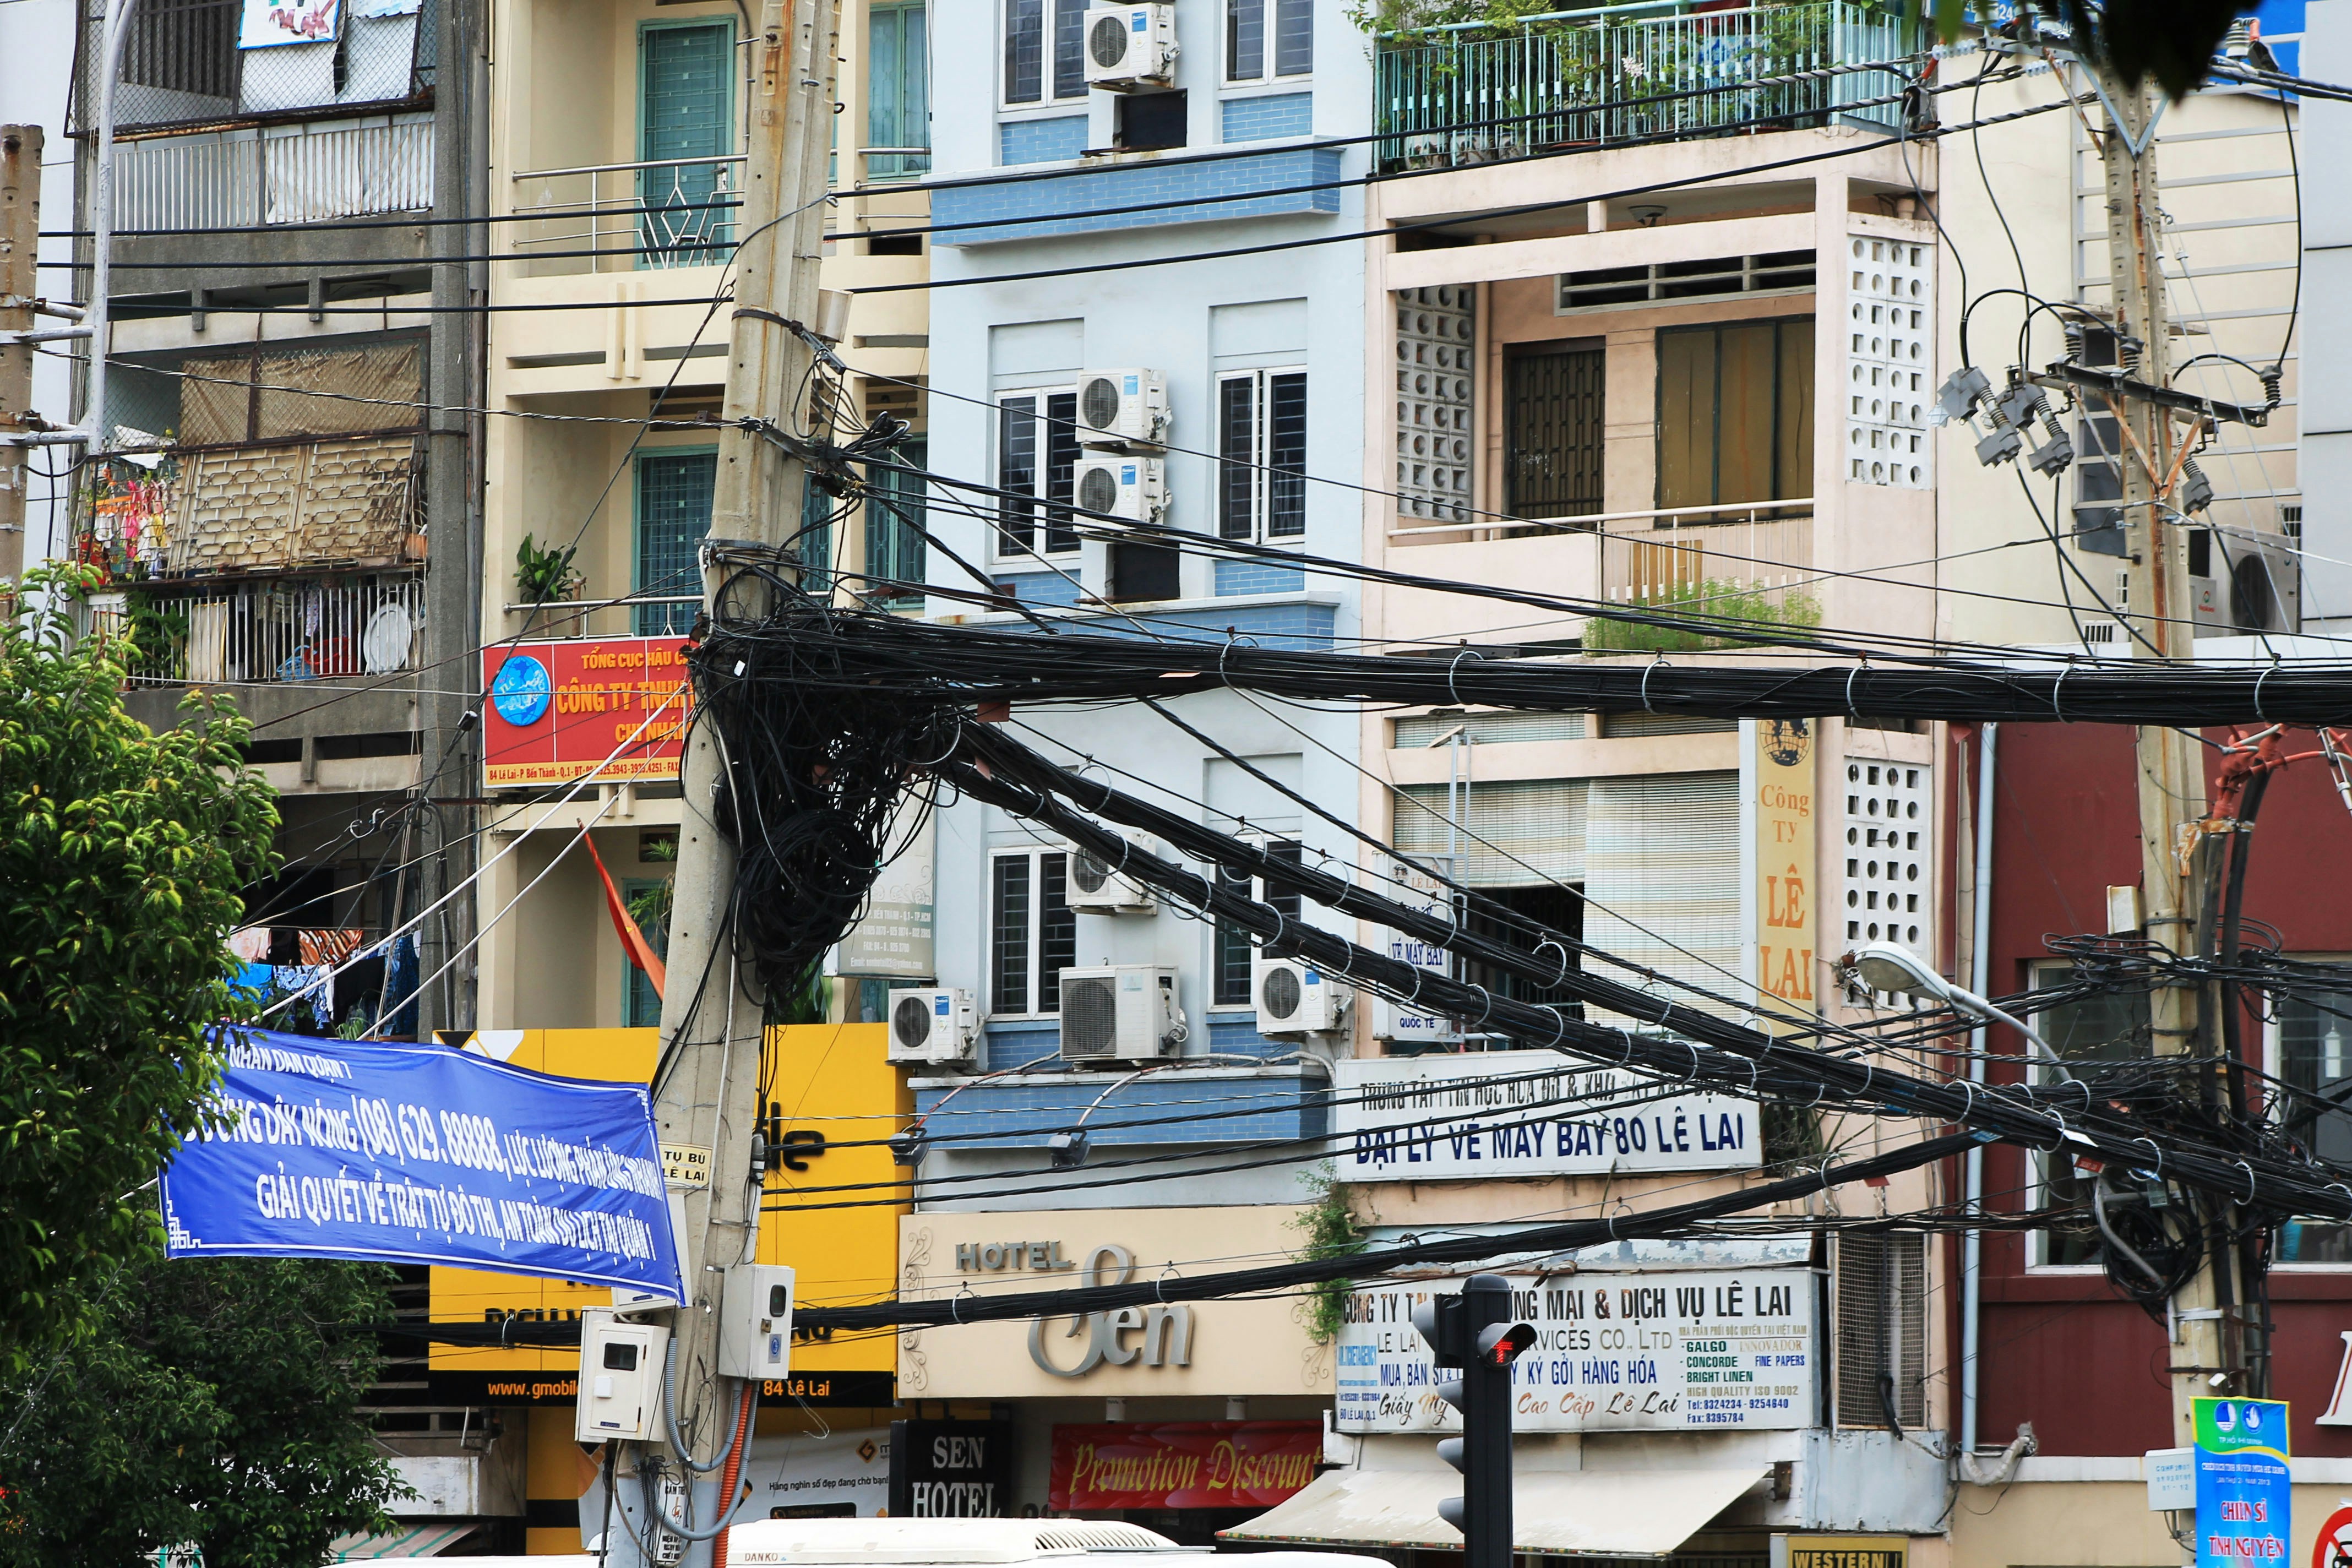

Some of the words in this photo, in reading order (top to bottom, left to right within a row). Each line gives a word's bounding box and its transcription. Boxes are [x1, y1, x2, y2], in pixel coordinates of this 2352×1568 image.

[581, 646, 616, 669] TỔNG
[618, 654, 644, 672] CỤC
[647, 647, 672, 671] HẬU
[557, 677, 605, 714] CÔNG
[609, 683, 633, 711] TY
[615, 723, 643, 742] CHI
[489, 771, 497, 780] 84
[1761, 785, 1809, 817] Công
[1767, 863, 1805, 928] LÊ
[1406, 938, 1423, 965] MÁY
[1427, 948, 1443, 966] BAY
[1761, 945, 1812, 1000] LAI
[1400, 1015, 1421, 1028] QUỐC
[302, 1054, 345, 1084] QUẬN
[259, 1094, 303, 1146] DÂY
[301, 1098, 360, 1153] NÓNG
[350, 1094, 405, 1166] (08)
[1355, 1128, 1397, 1170] ĐẠI
[1407, 1116, 1434, 1163] LÝ
[1449, 1117, 1482, 1161] VÉ
[1492, 1112, 1547, 1158] MÁY
[1557, 1118, 1610, 1157] BAY
[1614, 1117, 1647, 1155] 80
[1655, 1106, 1690, 1153] LÊ
[1700, 1113, 1743, 1151] LAI
[664, 1151, 682, 1163] TỤ
[662, 1166, 678, 1179] LÊ
[685, 1169, 705, 1182] LAI
[256, 1159, 302, 1219] GIẢI
[301, 1164, 362, 1227] QUYẾT
[361, 1168, 389, 1225] VỀ
[385, 1177, 430, 1241] TRẬT
[424, 1184, 452, 1244] TỰ
[449, 1184, 476, 1235] ĐÔ
[516, 1195, 556, 1244] TOÀN
[616, 1208, 651, 1270] QUẬN
[955, 1240, 1071, 1271] HOTEL
[1027, 1243, 1194, 1378] Sen
[1342, 1290, 1375, 1324] CÔNG
[1380, 1292, 1398, 1322] TY
[1547, 1289, 1584, 1327] MẠI
[1594, 1289, 1611, 1319] &
[1621, 1287, 1667, 1326] DỊCH
[1676, 1287, 1705, 1325] VỤ
[1716, 1280, 1743, 1317] LÊ
[1755, 1286, 1792, 1316] LAI
[1378, 1332, 1392, 1353] LE
[1686, 1341, 1727, 1353] GALGO
[1739, 1340, 1803, 1352] INNOVADOR
[1527, 1355, 1544, 1385] KÝ
[1551, 1352, 1574, 1385] GỞI
[1582, 1355, 1619, 1385] HÀNG
[1627, 1354, 1658, 1384] HÓA
[1686, 1356, 1739, 1368] CONCORDE
[1755, 1355, 1772, 1367] FINE
[1775, 1354, 1805, 1366] PAPERS
[1686, 1371, 1720, 1383] BRIGHT
[1723, 1370, 1753, 1382] LINEN
[488, 1379, 578, 1400] www.gmobil
[763, 1380, 784, 1397] 84
[788, 1380, 805, 1396] Lê
[809, 1380, 830, 1396] Lai
[1686, 1387, 1707, 1397] HIGH
[1710, 1386, 1751, 1398] QUALITY
[1754, 1386, 1771, 1396] ISO
[1773, 1385, 1799, 1396] 9002
[1517, 1392, 1549, 1415] Cao
[1559, 1391, 1596, 1421] Cấp
[1604, 1391, 1636, 1415] Lê
[1639, 1390, 1680, 1415] Lai
[1749, 1398, 1789, 1409] 9254640
[933, 1436, 985, 1469] SEN
[1069, 1441, 1199, 1495] Promotion
[1207, 1439, 1324, 1491] Discount
[822, 1478, 837, 1489] đẹp
[838, 1477, 857, 1488] đang
[912, 1482, 1001, 1518] HOTEL
[744, 1552, 778, 1562] DANKO
[1794, 1551, 1885, 1568] WESTERN
